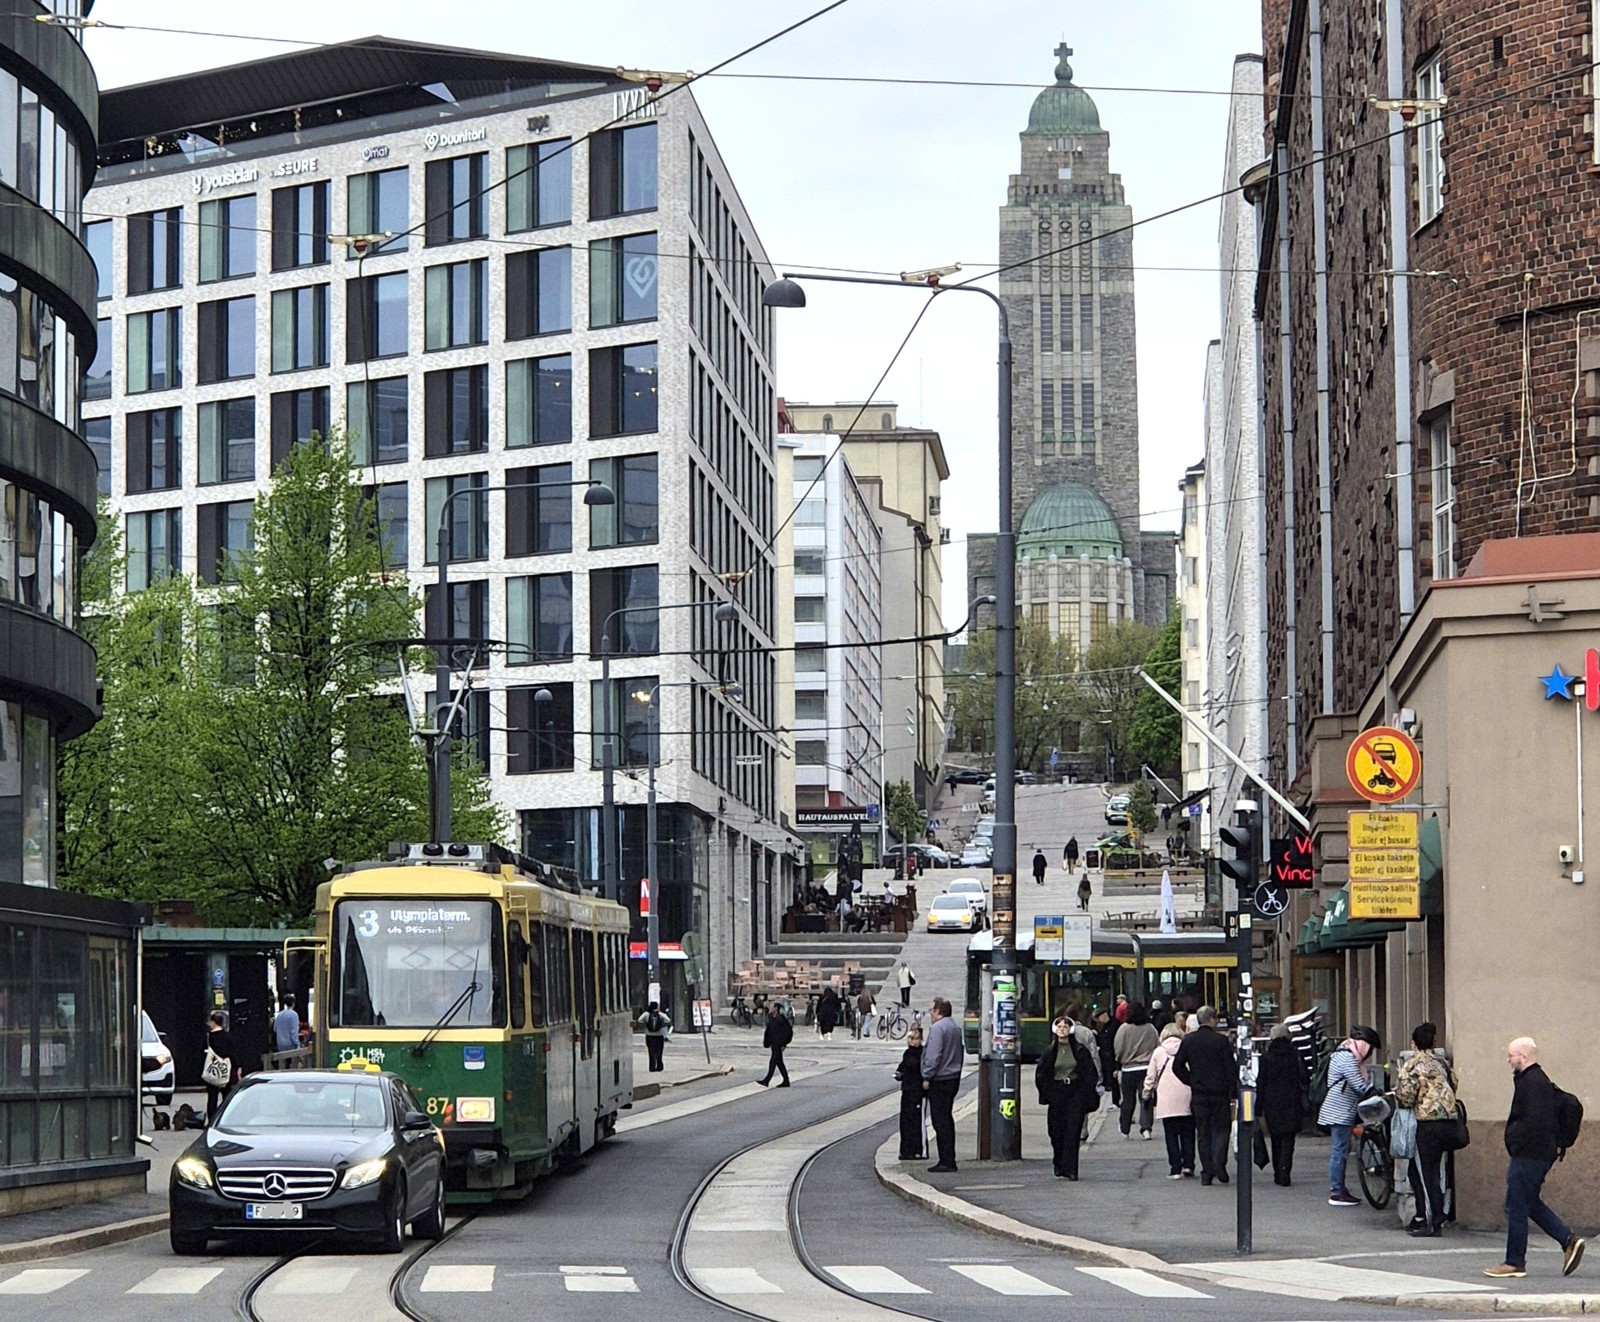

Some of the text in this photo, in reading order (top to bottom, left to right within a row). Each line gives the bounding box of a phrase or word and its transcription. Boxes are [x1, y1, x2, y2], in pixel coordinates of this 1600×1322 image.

[440, 127, 487, 147] Duunitori
[278, 158, 318, 177] SEURE
[205, 167, 258, 193] yousician
[1379, 836, 1387, 846] ej
[1388, 836, 1411, 844] bussar
[1387, 854, 1415, 863] takseja
[1386, 866, 1416, 874] taxibilar
[1390, 884, 1416, 893] sallittu
[1357, 895, 1413, 905] Servicekörning
[358, 909, 380, 938] 3
[367, 1048, 385, 1057] HSL
